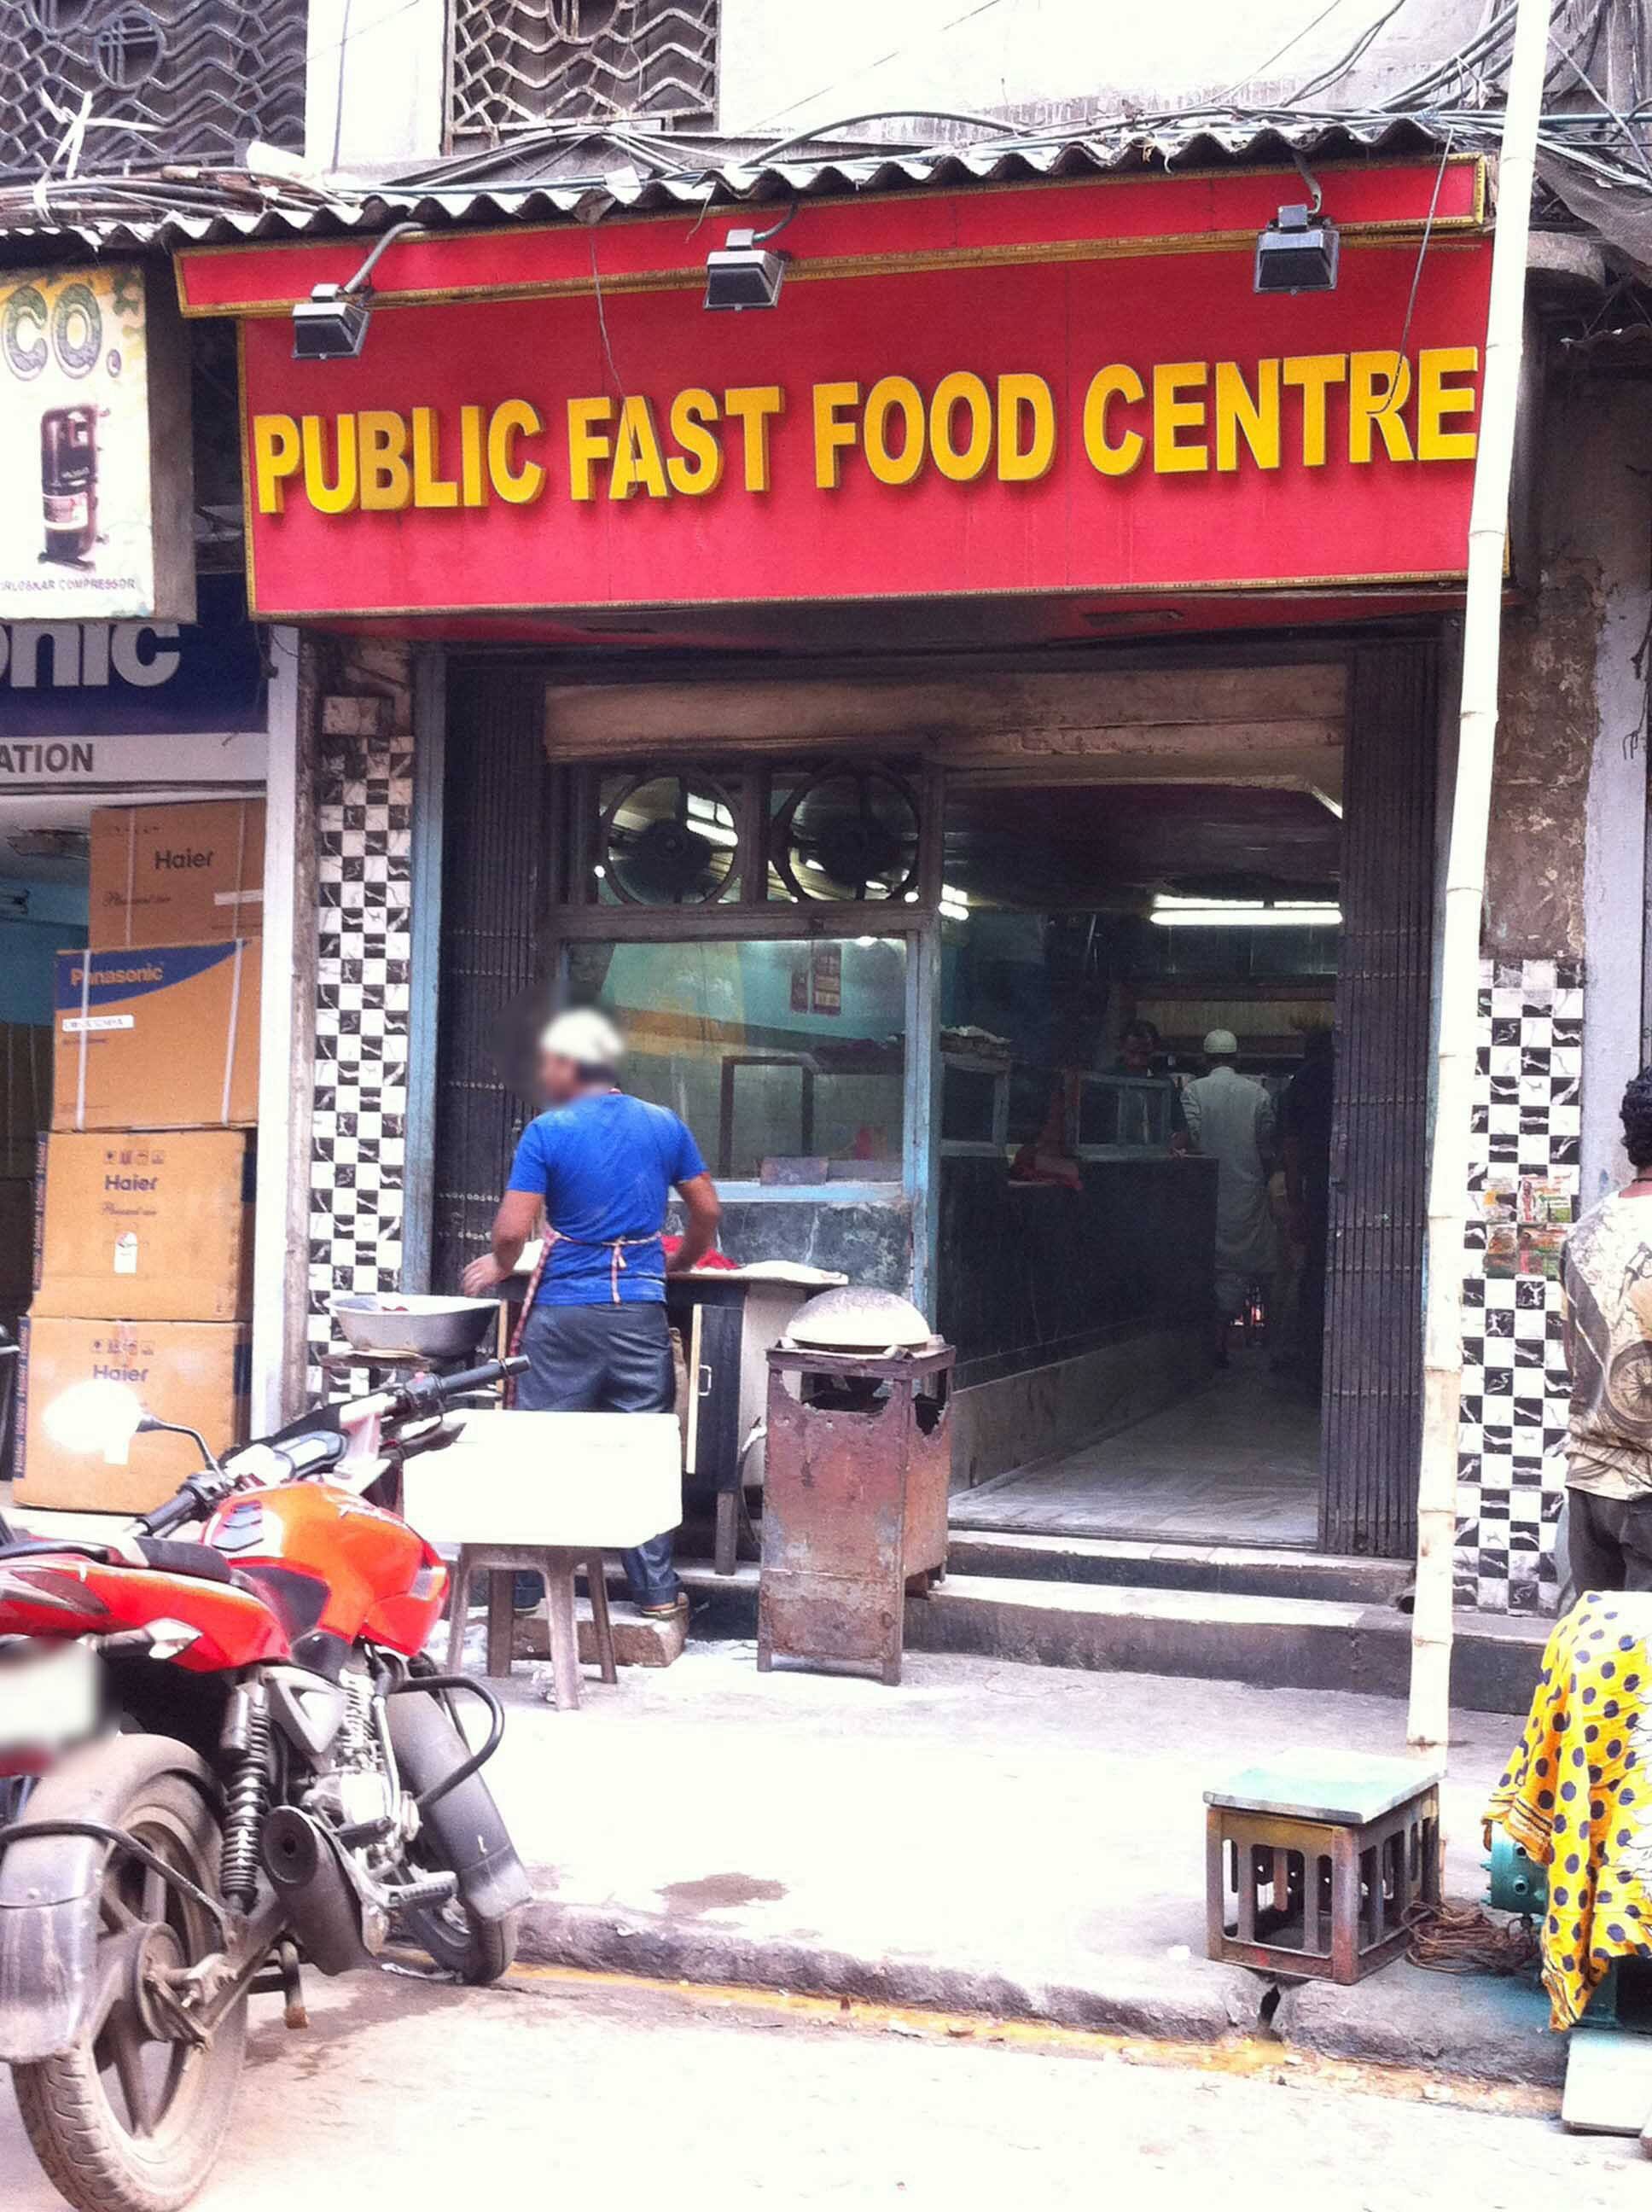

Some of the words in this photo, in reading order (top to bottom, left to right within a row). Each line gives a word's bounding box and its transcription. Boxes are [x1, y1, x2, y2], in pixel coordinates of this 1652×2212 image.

[253, 399, 546, 515] PUBLIC
[567, 386, 785, 501] FAST
[813, 371, 1057, 489] FOOD
[1082, 346, 1479, 476] CENTRE
[0, 624, 181, 687] nic
[0, 743, 93, 773] ATION
[154, 848, 214, 870] Haier
[104, 1174, 158, 1191] Haier
[93, 1365, 148, 1382] Haier
